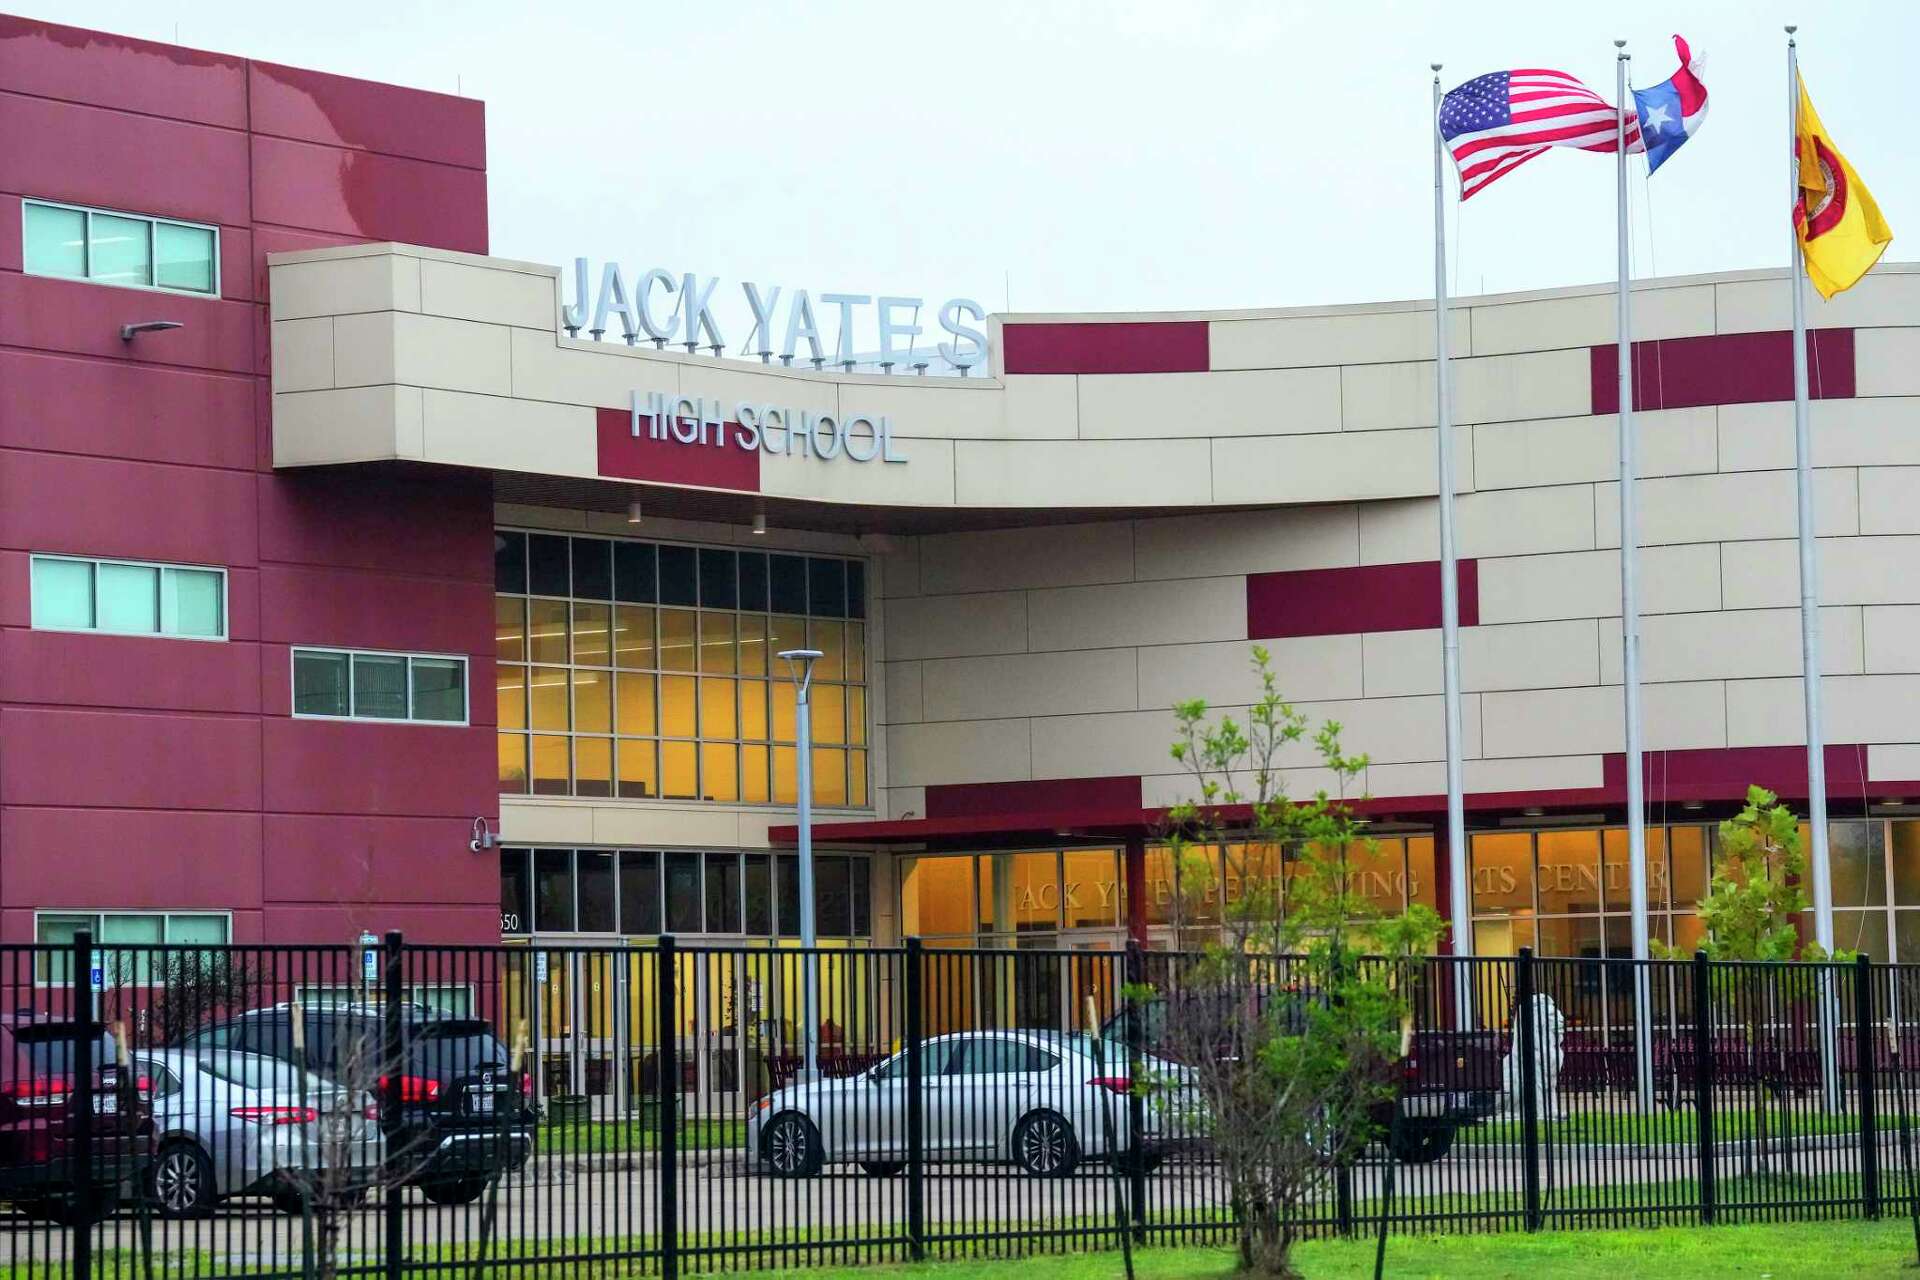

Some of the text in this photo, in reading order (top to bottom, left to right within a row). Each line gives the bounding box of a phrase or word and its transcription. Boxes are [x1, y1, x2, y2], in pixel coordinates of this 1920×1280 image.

[563, 258, 989, 367] JACK YATES
[630, 389, 909, 464] HIGH SCHOOL
[1530, 861, 1669, 893] CENTR
